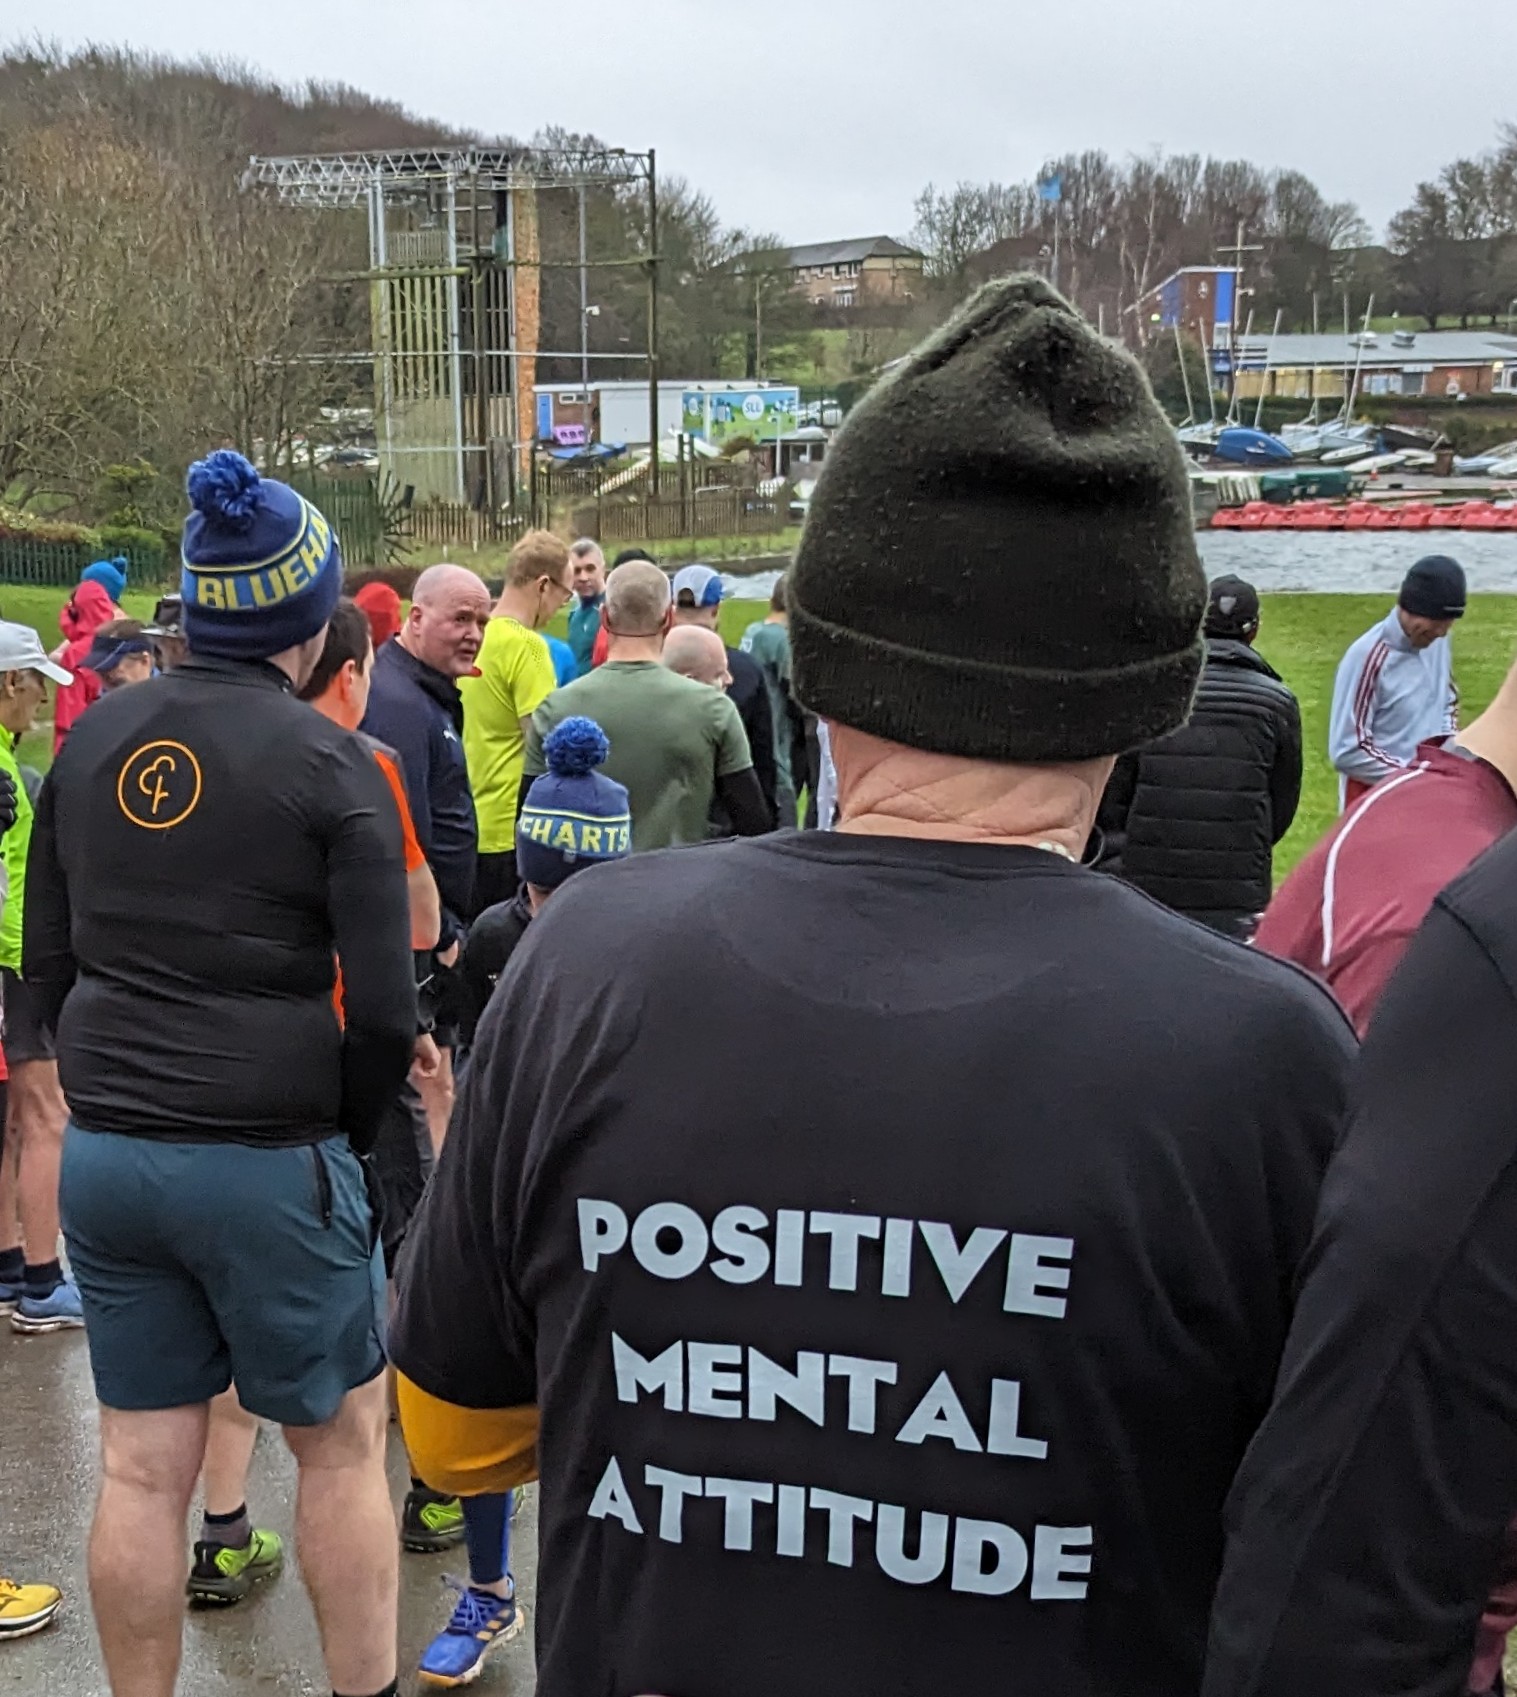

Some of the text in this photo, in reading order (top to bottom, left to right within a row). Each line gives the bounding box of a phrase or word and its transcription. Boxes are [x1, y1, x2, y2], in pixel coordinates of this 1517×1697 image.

[578, 1199, 1074, 1318] POSITIVE
[612, 1331, 1048, 1459] MENTAL
[587, 1456, 1093, 1600] ATTITUDE
